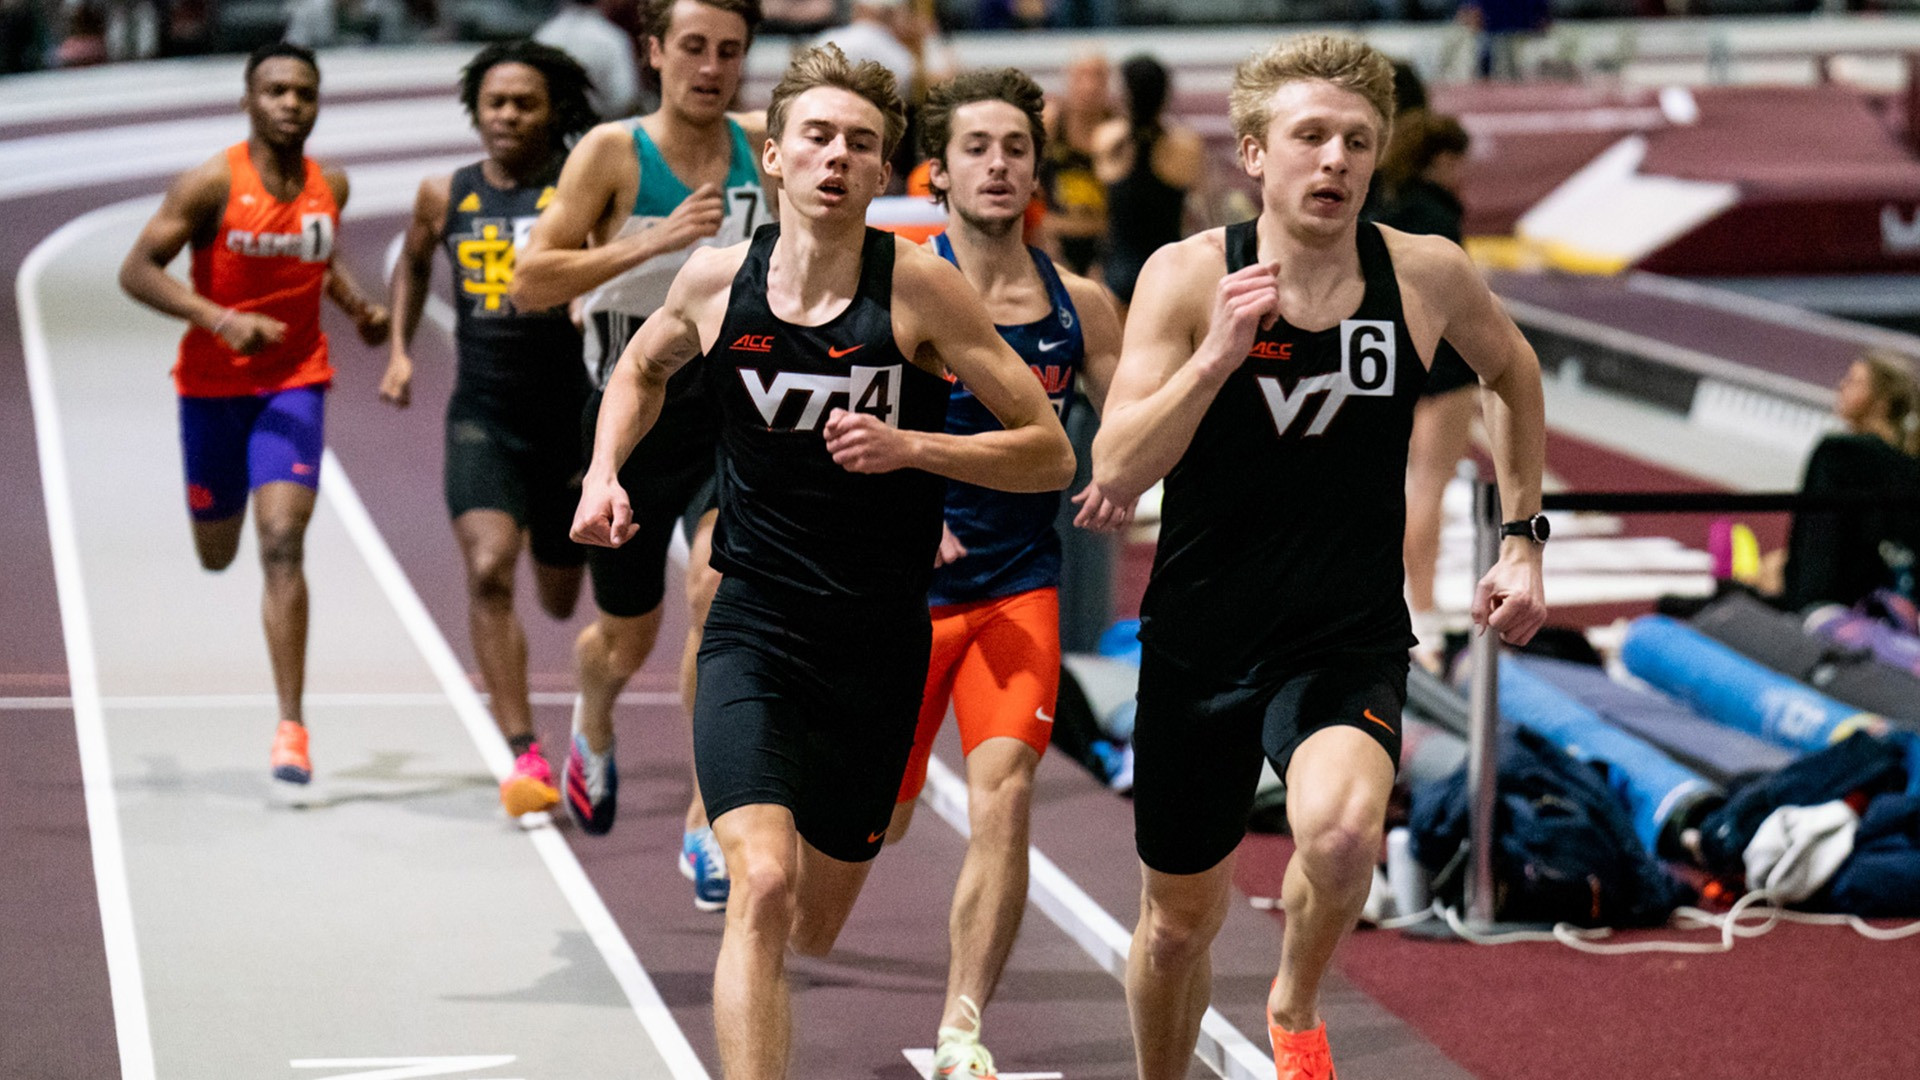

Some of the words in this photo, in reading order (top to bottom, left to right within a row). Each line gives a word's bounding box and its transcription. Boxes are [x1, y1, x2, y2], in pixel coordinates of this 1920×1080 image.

[309, 220, 322, 256] 1
[734, 192, 758, 238] 7
[729, 333, 776, 352] ACC
[1249, 341, 1293, 360] ACC
[1349, 325, 1388, 391] 6
[736, 367, 850, 432] VT
[855, 370, 893, 424] 4
